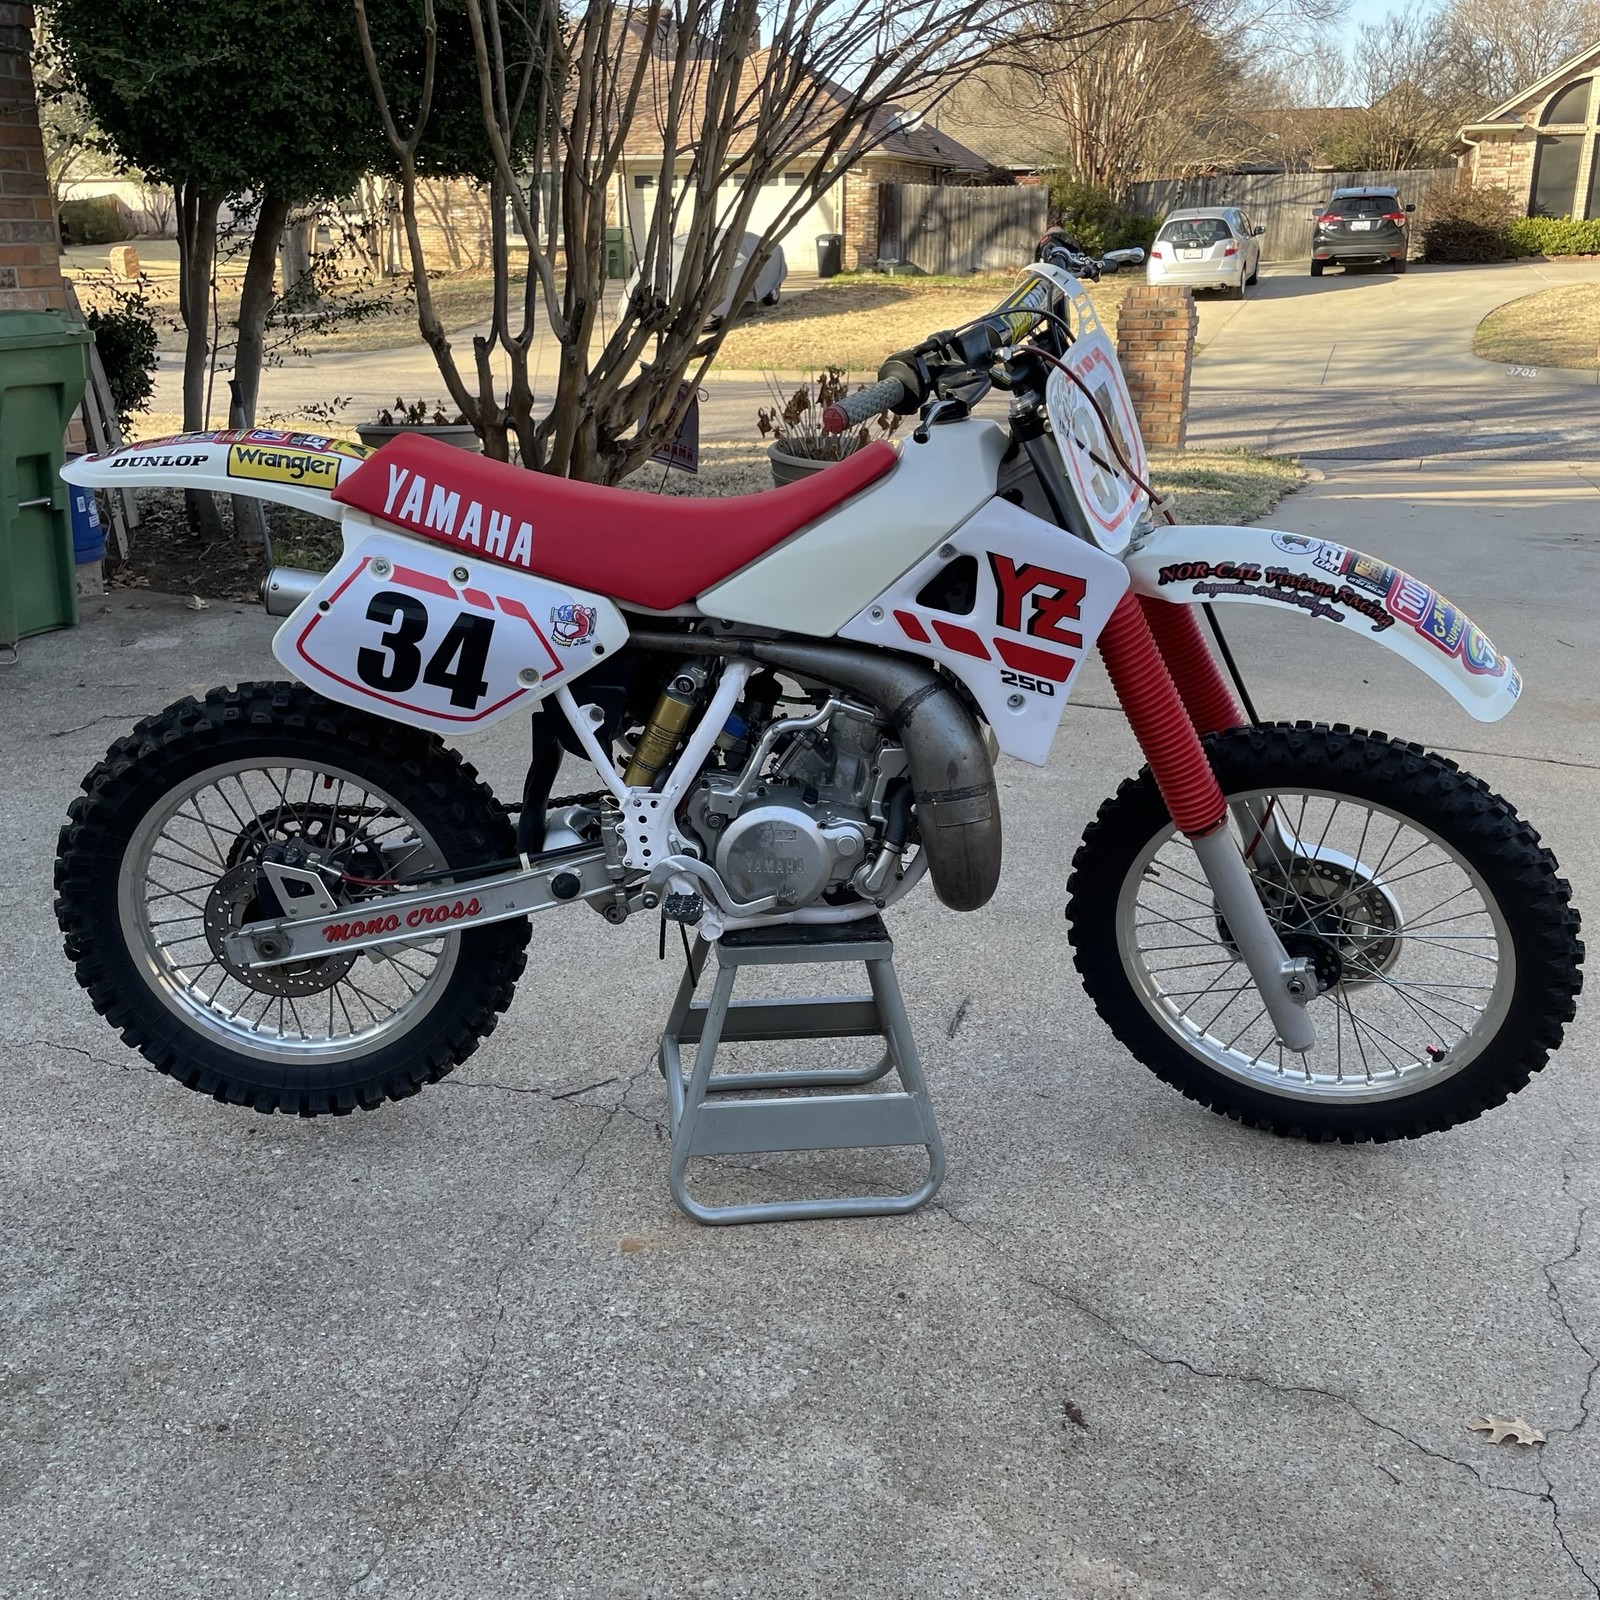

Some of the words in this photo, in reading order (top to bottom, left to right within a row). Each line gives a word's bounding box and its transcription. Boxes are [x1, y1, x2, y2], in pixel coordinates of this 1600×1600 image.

[1506, 366, 1537, 377] 3705
[110, 455, 209, 468] DUNLOP
[236, 446, 335, 479] Wrangler
[383, 463, 533, 567] YAMAHA
[986, 550, 1088, 650] YZ
[1159, 562, 1261, 584] NOR-CAL
[1266, 568, 1334, 599] Vintage
[1333, 586, 1394, 631] Racing
[1397, 578, 1428, 615] 100
[357, 591, 495, 710] 34
[1000, 669, 1055, 697] 250
[746, 857, 805, 874] YAMAHA
[322, 914, 401, 943] mono
[405, 898, 483, 928] cross
